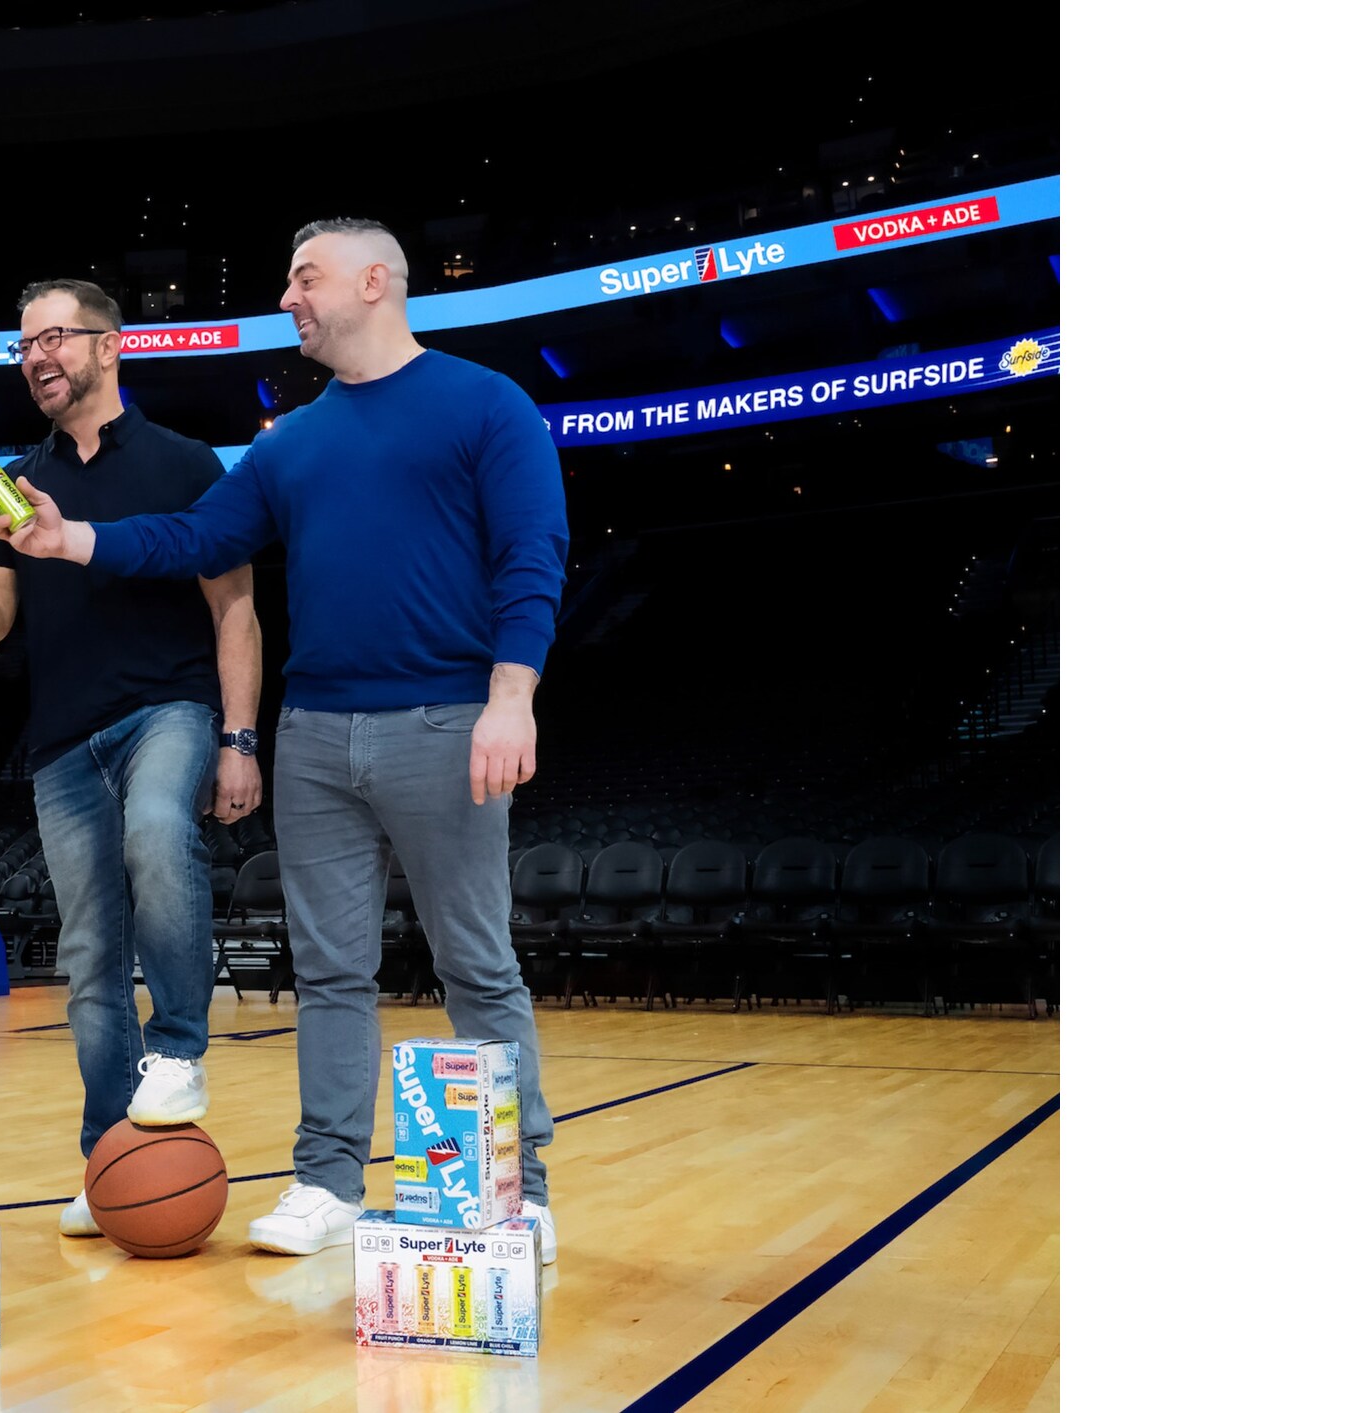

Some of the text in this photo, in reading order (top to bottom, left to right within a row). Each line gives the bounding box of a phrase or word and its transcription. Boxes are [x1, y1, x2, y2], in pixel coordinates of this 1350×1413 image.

[853, 205, 981, 243] VODKA + ADE
[599, 242, 785, 295] Super Lyte
[176, 335, 186, 344] +
[189, 331, 222, 346] ADE
[1000, 345, 1049, 370] Surfside
[562, 357, 984, 436] FROM THE MAKERS OF SURFSIDE
[1, 478, 24, 504] Super
[445, 1062, 469, 1072] Super
[393, 1046, 444, 1138] Super
[439, 1160, 482, 1230] Lyte
[405, 1194, 428, 1204] Super
[400, 1237, 486, 1253] Super Lyte
[386, 1270, 394, 1319] Super Lyte
[422, 1272, 430, 1321] Super Lyte
[458, 1274, 467, 1323] Super Lyte
[494, 1276, 503, 1325] Super Lyte
